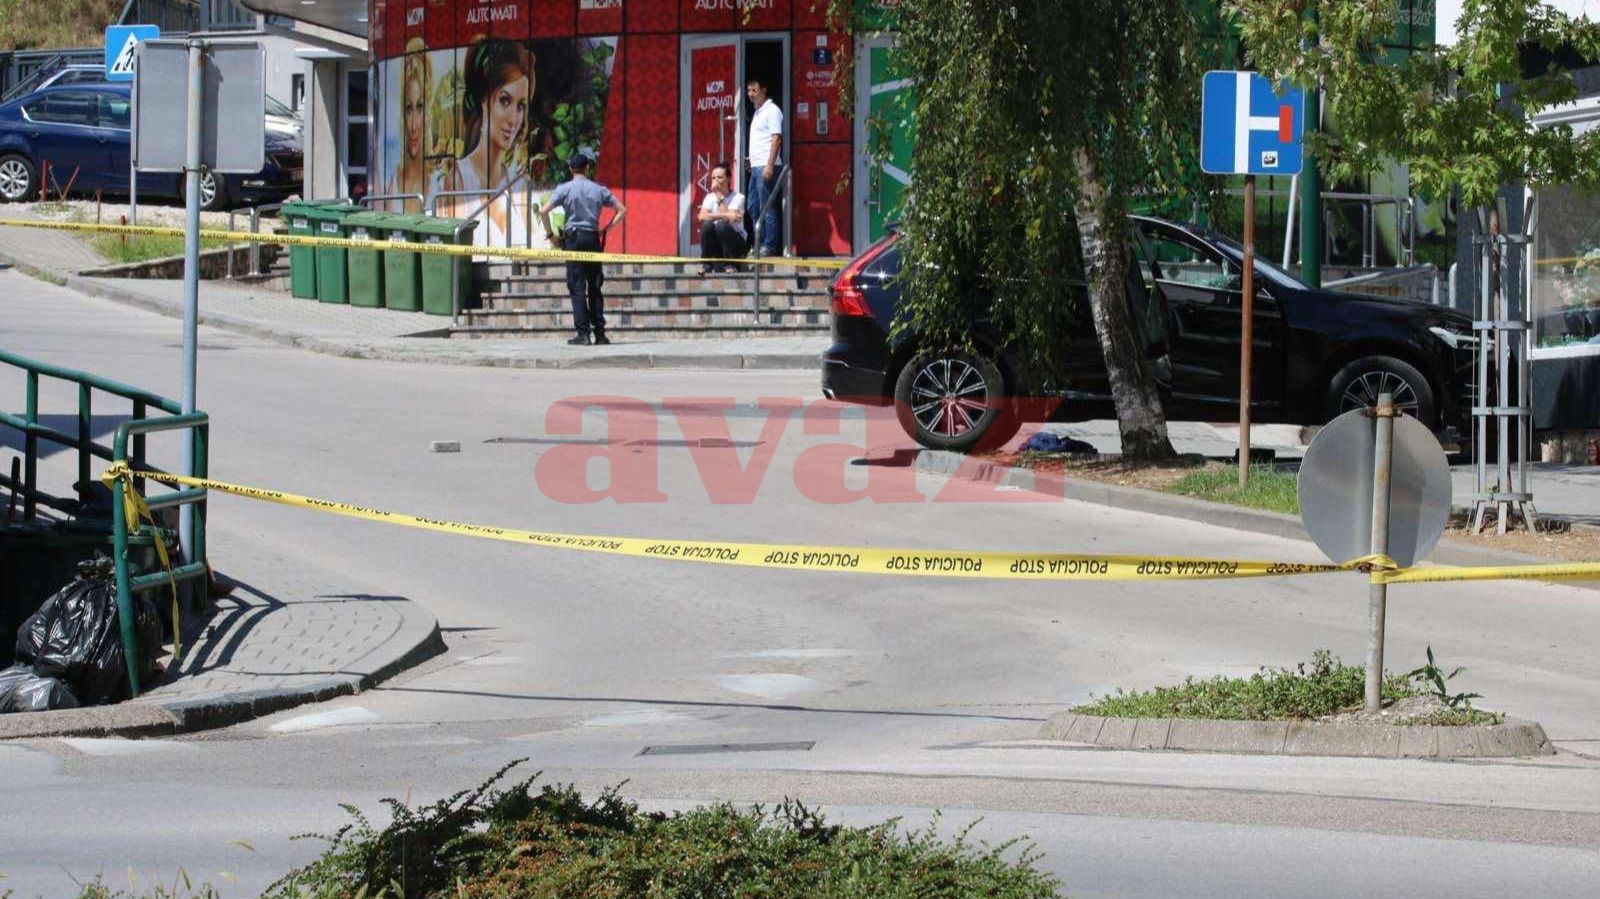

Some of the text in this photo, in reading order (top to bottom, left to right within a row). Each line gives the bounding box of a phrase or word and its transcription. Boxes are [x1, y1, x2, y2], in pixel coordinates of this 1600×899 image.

[466, 5, 517, 24] AUTOMATI
[697, 95, 733, 111] AUTOMATI
[645, 544, 740, 560] POLICIJA STOP
[764, 551, 860, 568] POLICIJA STOP
[886, 556, 983, 572] POLICIJA STOP
[1010, 559, 1109, 574] POLICIJA STOP
[1136, 561, 1239, 575] POLICIJA STOP
[1266, 562, 1304, 574] STOP
